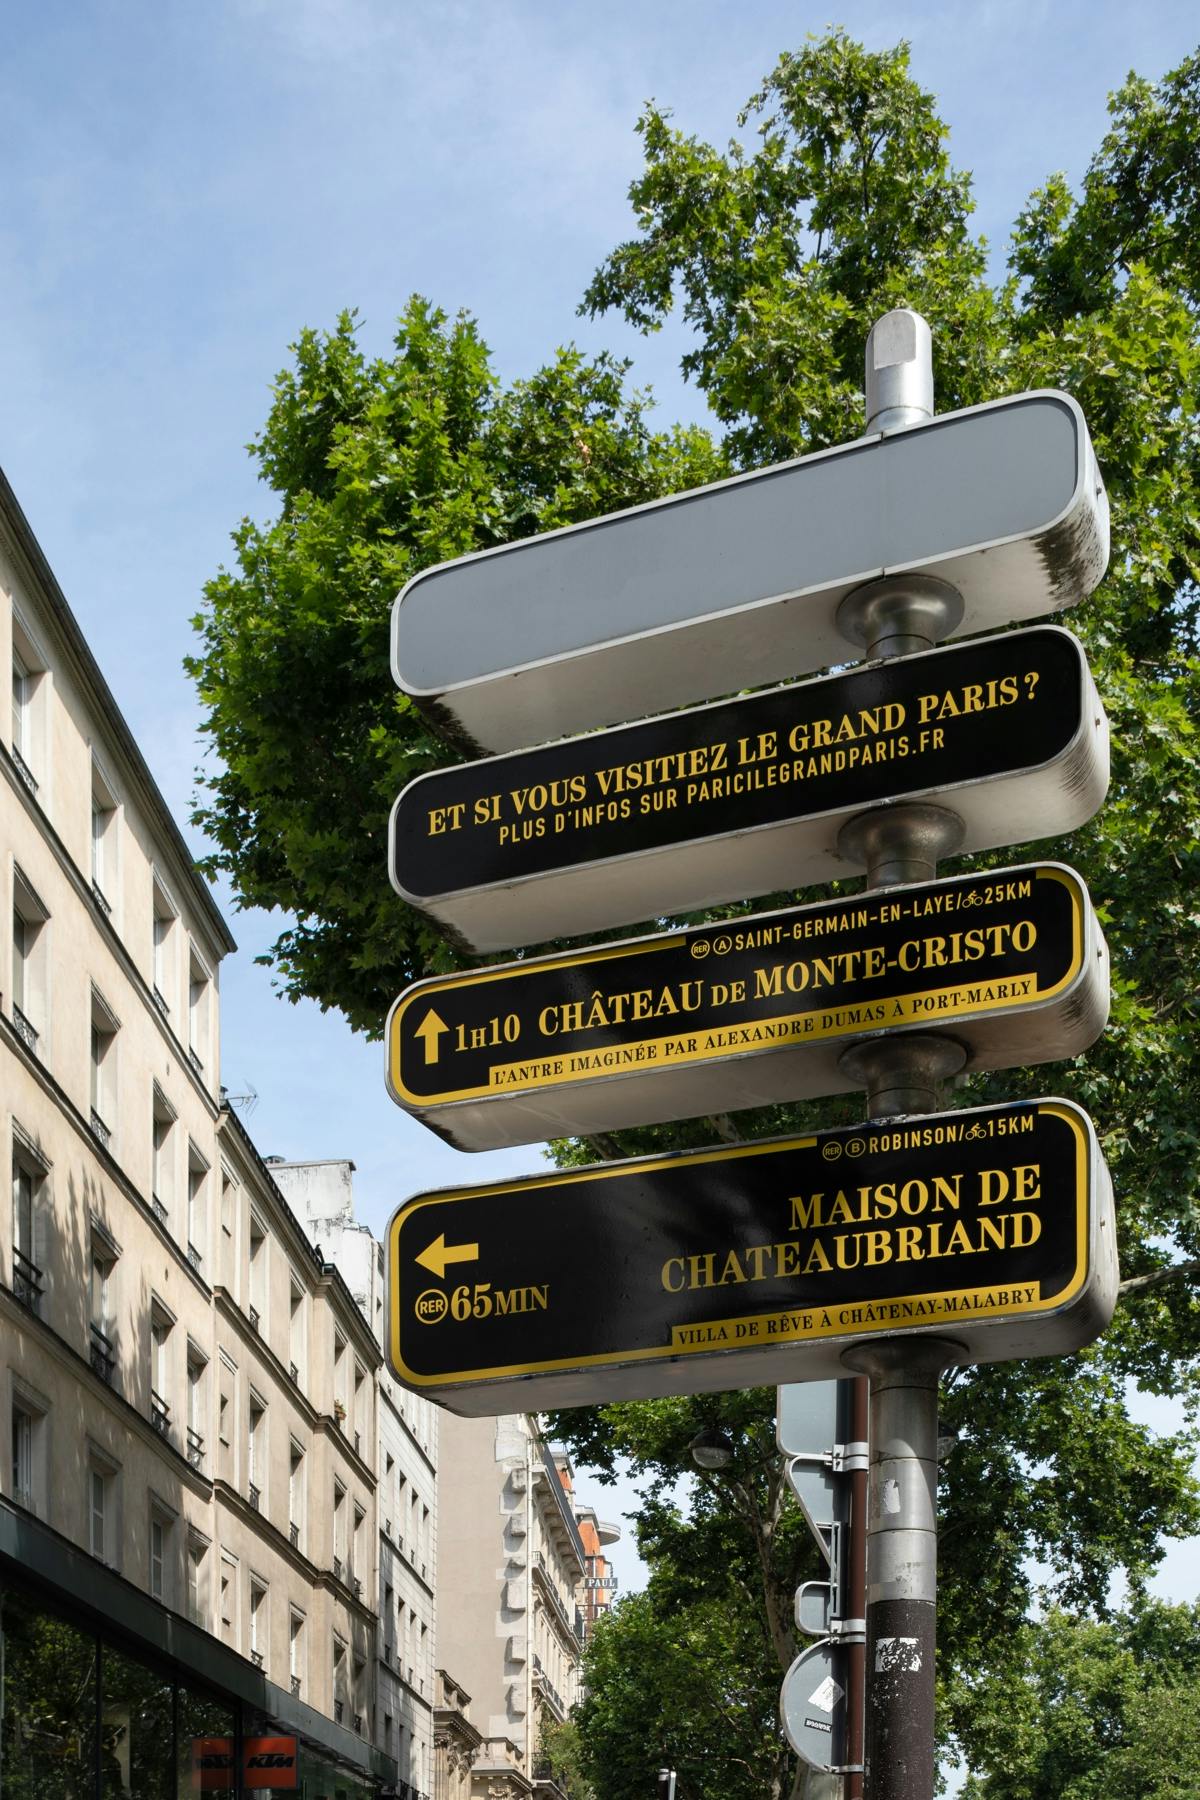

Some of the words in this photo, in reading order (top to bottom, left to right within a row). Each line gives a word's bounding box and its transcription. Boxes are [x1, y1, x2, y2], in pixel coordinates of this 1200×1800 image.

[428, 804, 465, 835] ET
[475, 795, 501, 824] SI
[511, 776, 586, 815] VOUS
[596, 743, 728, 795] VISITIEZ
[738, 732, 777, 765] LE
[788, 704, 906, 752] GRAND
[500, 818, 545, 845] PLUS
[555, 799, 631, 833] D'INFOS
[641, 789, 677, 813] SUR
[688, 728, 944, 804] PARICILEGRANDPARIS.FR
[985, 880, 1031, 905] 25KM
[538, 980, 704, 1036] CHÂTEAU
[711, 981, 746, 1008] DE
[754, 920, 1037, 999] MONTE-CRISTO
[494, 1061, 563, 1085] L'ANTRE
[570, 1043, 657, 1072] IMAGINÉE
[664, 1037, 698, 1056] PAR
[704, 1018, 814, 1050] ALEXANDRE
[822, 1005, 885, 1029] DUMAS
[892, 996, 905, 1017] À
[912, 980, 1032, 1014] PORT-MARLY
[986, 1114, 1034, 1137] 15KM
[788, 1174, 964, 1231] MAISON
[977, 1164, 1041, 1206] DE
[661, 1211, 1042, 1293] CHATEAUBRIAND
[678, 1328, 729, 1346] VILLA
[735, 1321, 759, 1338] DE
[767, 1315, 813, 1334] RÊVE
[821, 1309, 832, 1327] À
[839, 1288, 1036, 1325] CHÂTENAY-MALABRY
[588, 1578, 615, 1587] PAUL
[246, 1753, 294, 1769] KTM
